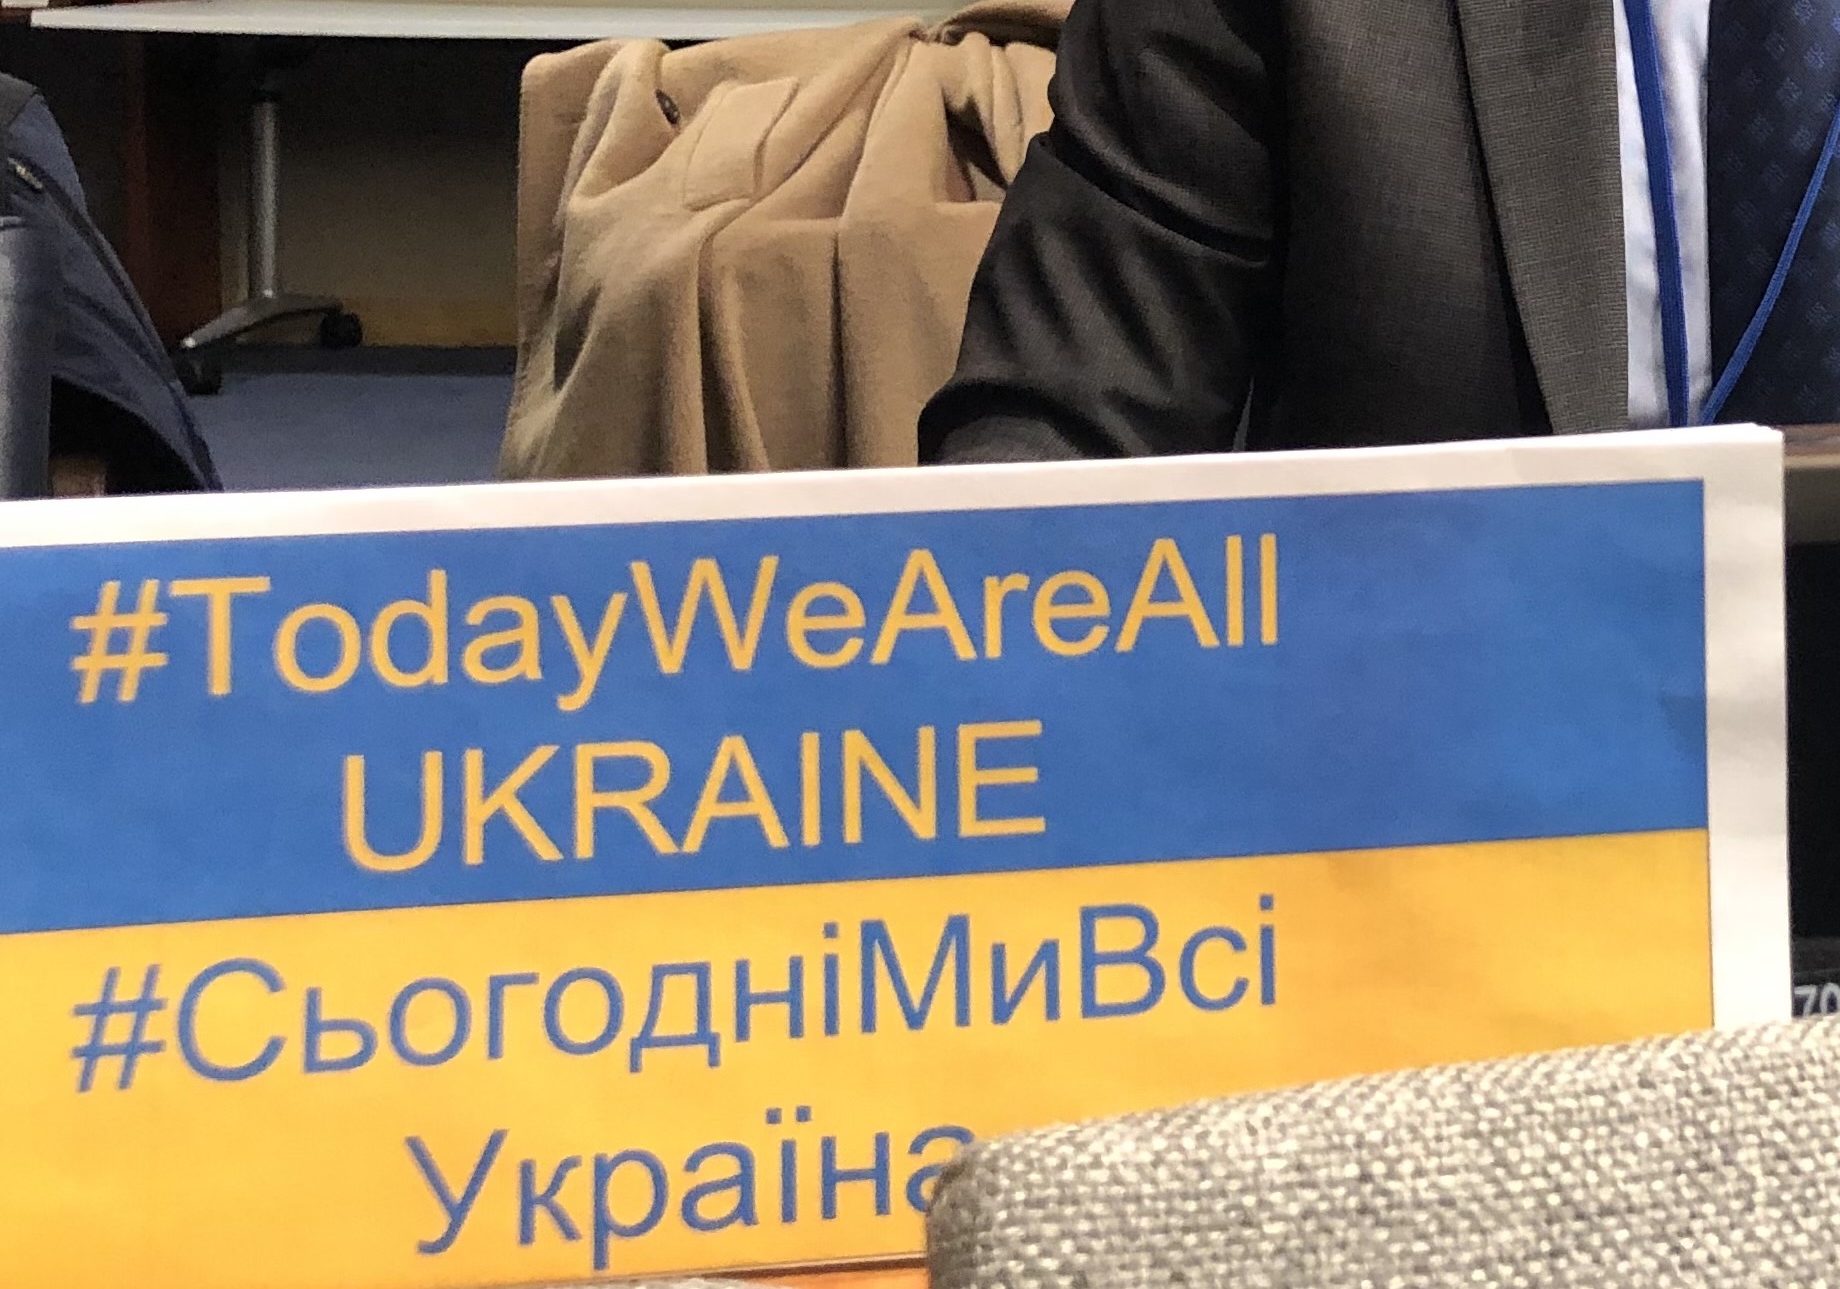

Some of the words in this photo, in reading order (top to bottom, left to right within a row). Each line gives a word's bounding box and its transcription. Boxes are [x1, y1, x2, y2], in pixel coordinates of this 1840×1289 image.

[71, 532, 1280, 712] #TodayWeAreAll
[343, 719, 1047, 873] UKRAINE
[71, 894, 1278, 1093] #СьогодніМиВсі
